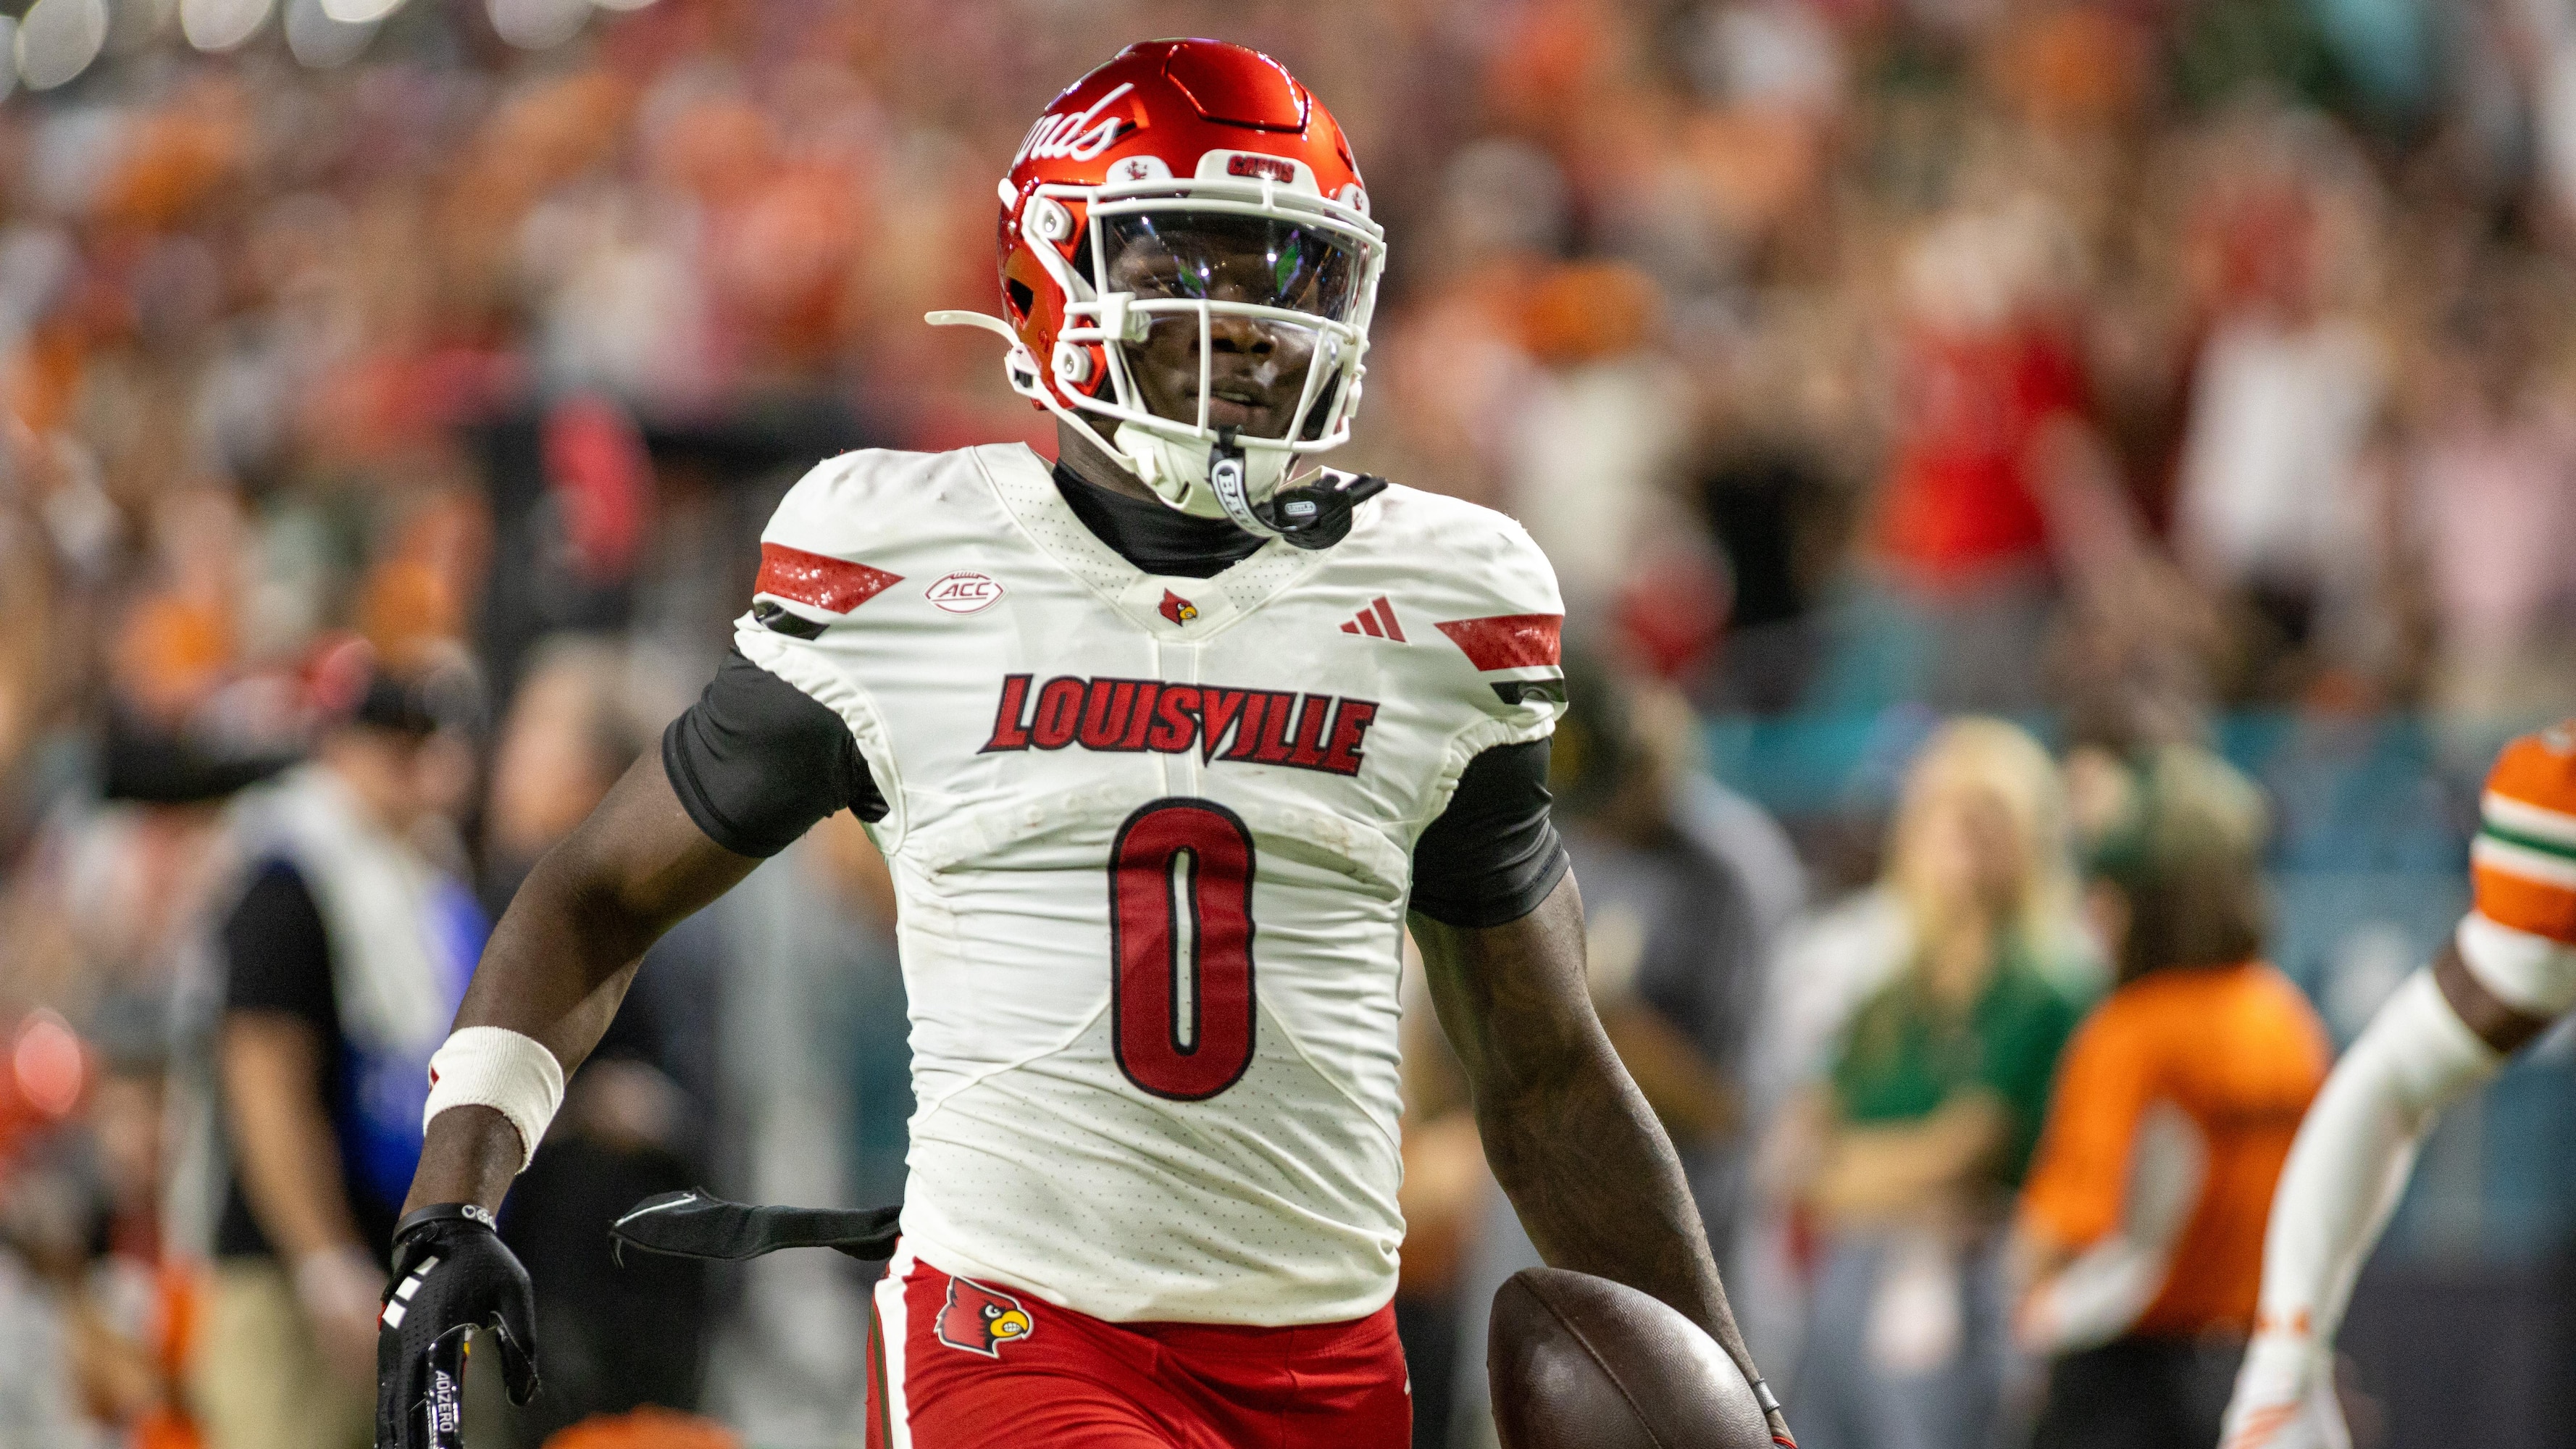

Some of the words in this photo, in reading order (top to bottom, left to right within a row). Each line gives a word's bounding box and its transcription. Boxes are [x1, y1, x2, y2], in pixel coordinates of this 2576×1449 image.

[937, 581, 992, 598] ACC
[976, 673, 1380, 777] LOUISVILLE
[1107, 796, 1257, 1102] 0
[435, 1370, 454, 1432] ADIZERO
